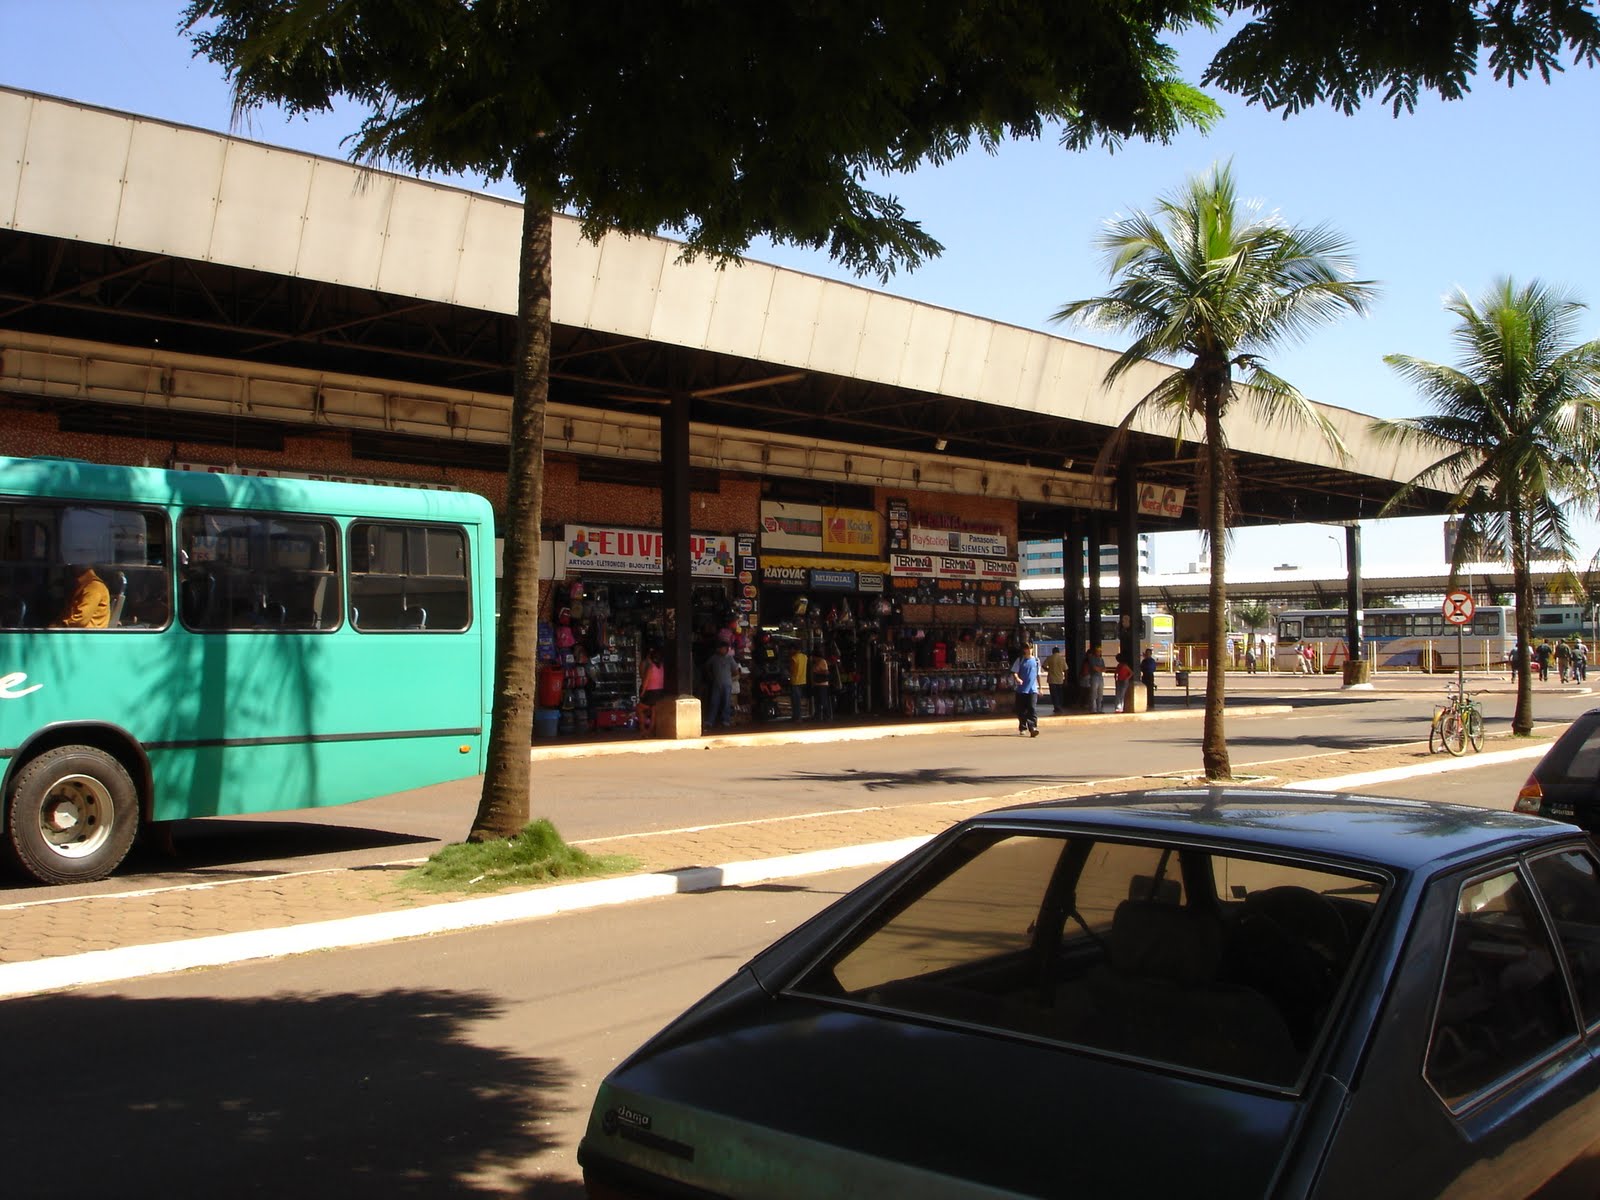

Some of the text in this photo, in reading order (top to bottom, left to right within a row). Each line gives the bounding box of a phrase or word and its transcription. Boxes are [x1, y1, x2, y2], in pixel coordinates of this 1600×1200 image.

[848, 519, 873, 531] Kodak
[912, 534, 949, 548] PlayStation
[969, 534, 998, 545] Panasonic
[961, 545, 990, 554] SIEMENS
[764, 567, 806, 579] RAYOVAC
[815, 574, 852, 584] MUNDIAL
